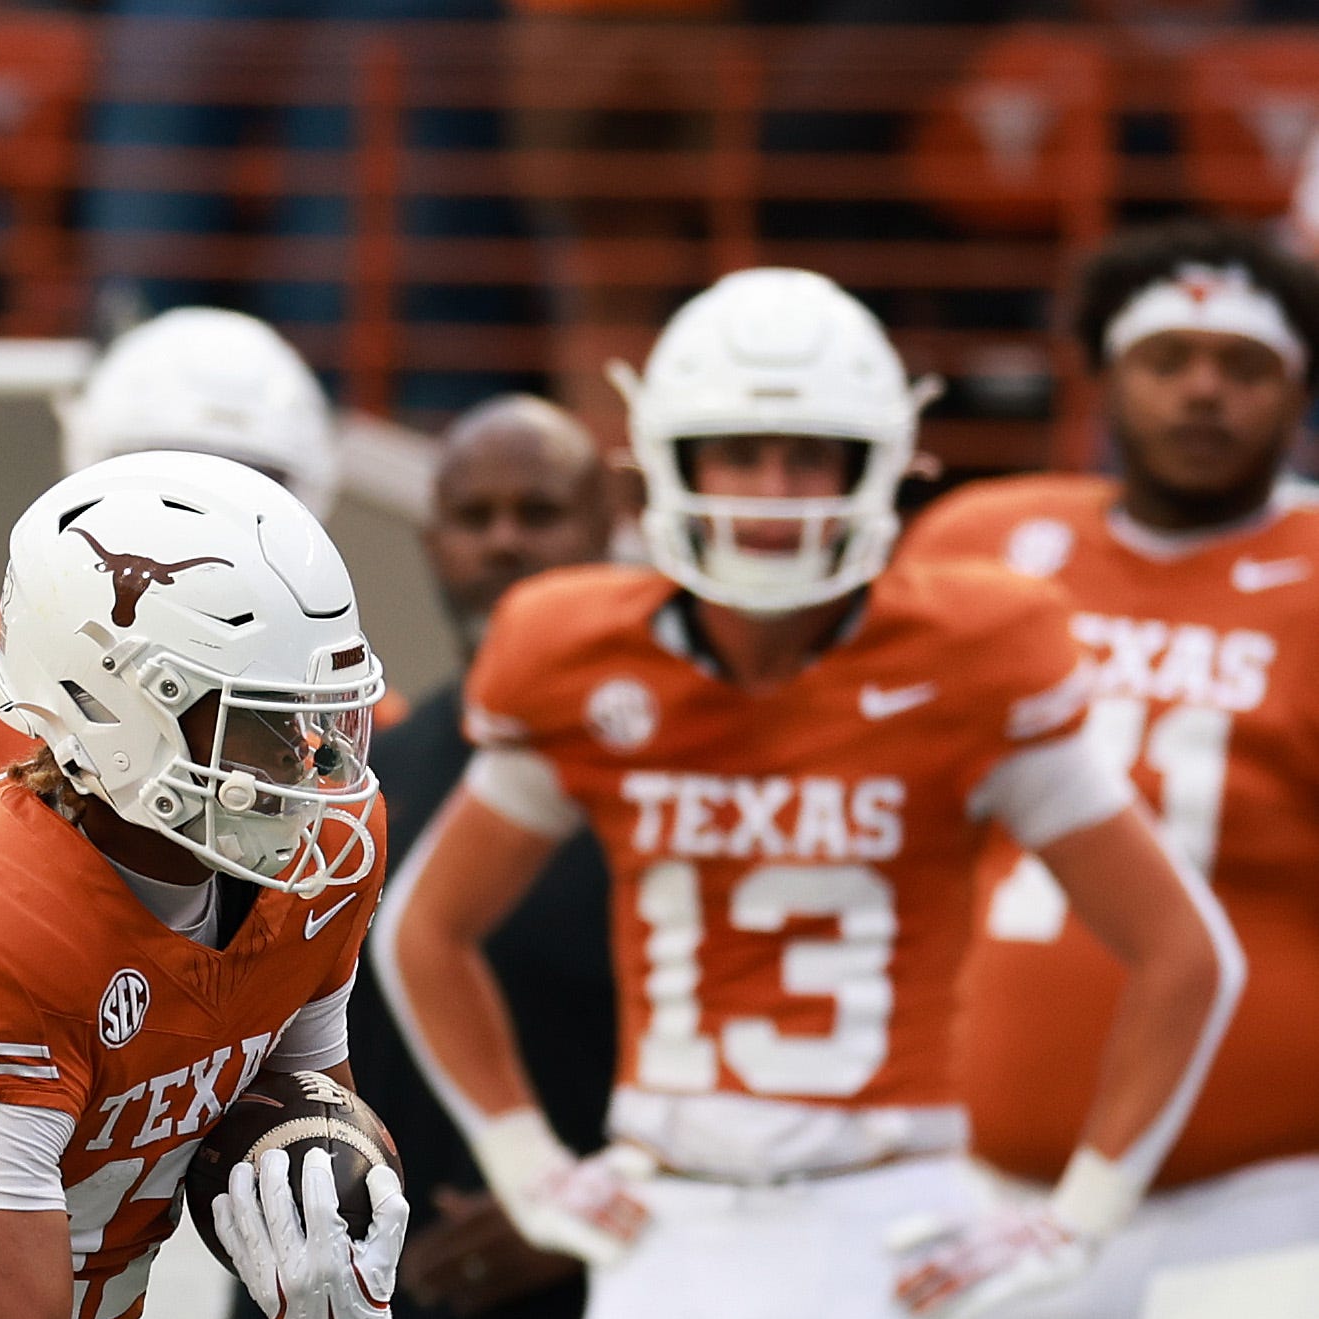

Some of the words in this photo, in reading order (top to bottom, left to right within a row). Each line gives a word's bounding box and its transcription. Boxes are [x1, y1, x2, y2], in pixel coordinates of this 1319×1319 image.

[621, 770, 907, 862] TEXAS
[102, 975, 147, 1044] SEC
[636, 860, 898, 1097] 13
[85, 1008, 300, 1151] TEXA
